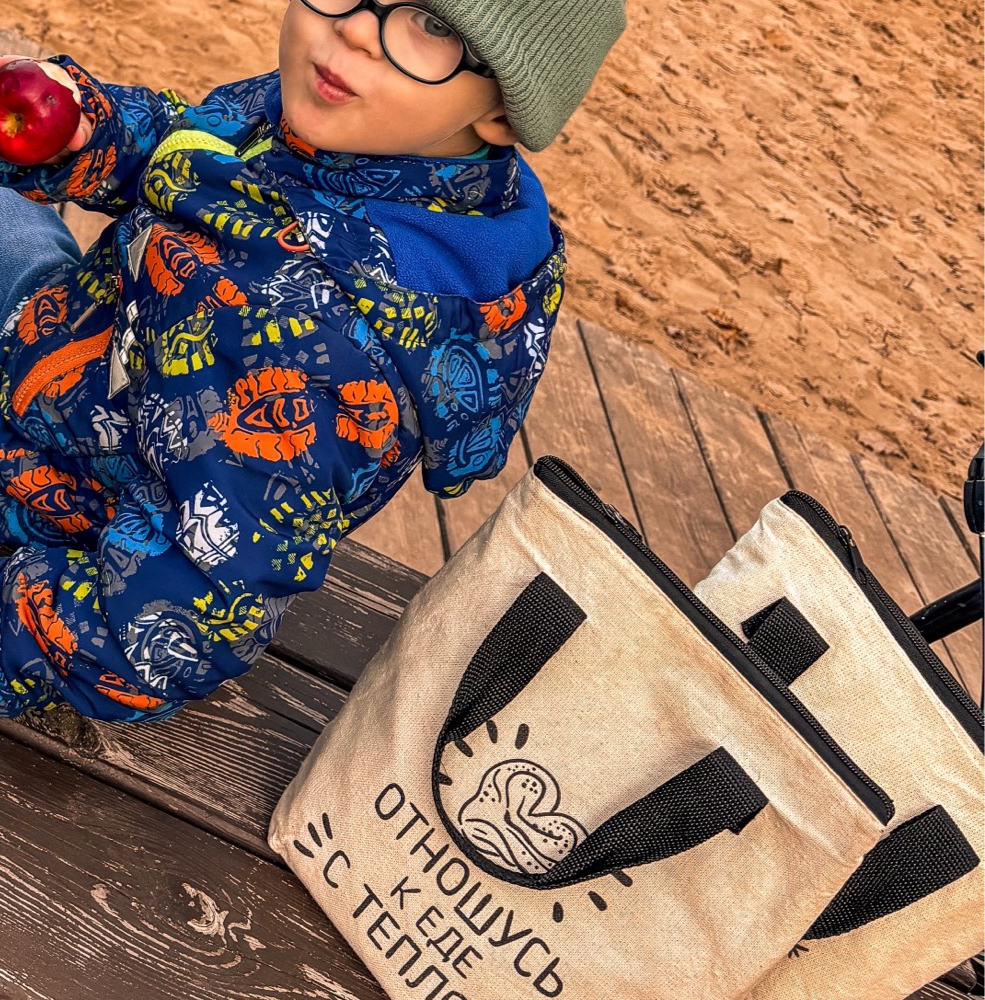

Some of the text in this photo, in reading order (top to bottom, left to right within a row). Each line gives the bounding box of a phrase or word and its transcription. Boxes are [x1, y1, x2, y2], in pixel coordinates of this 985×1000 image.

[323, 850, 351, 889] С
[374, 783, 564, 998] ОТНОШУСЬ
[390, 876, 484, 979] К ЕДЕ
